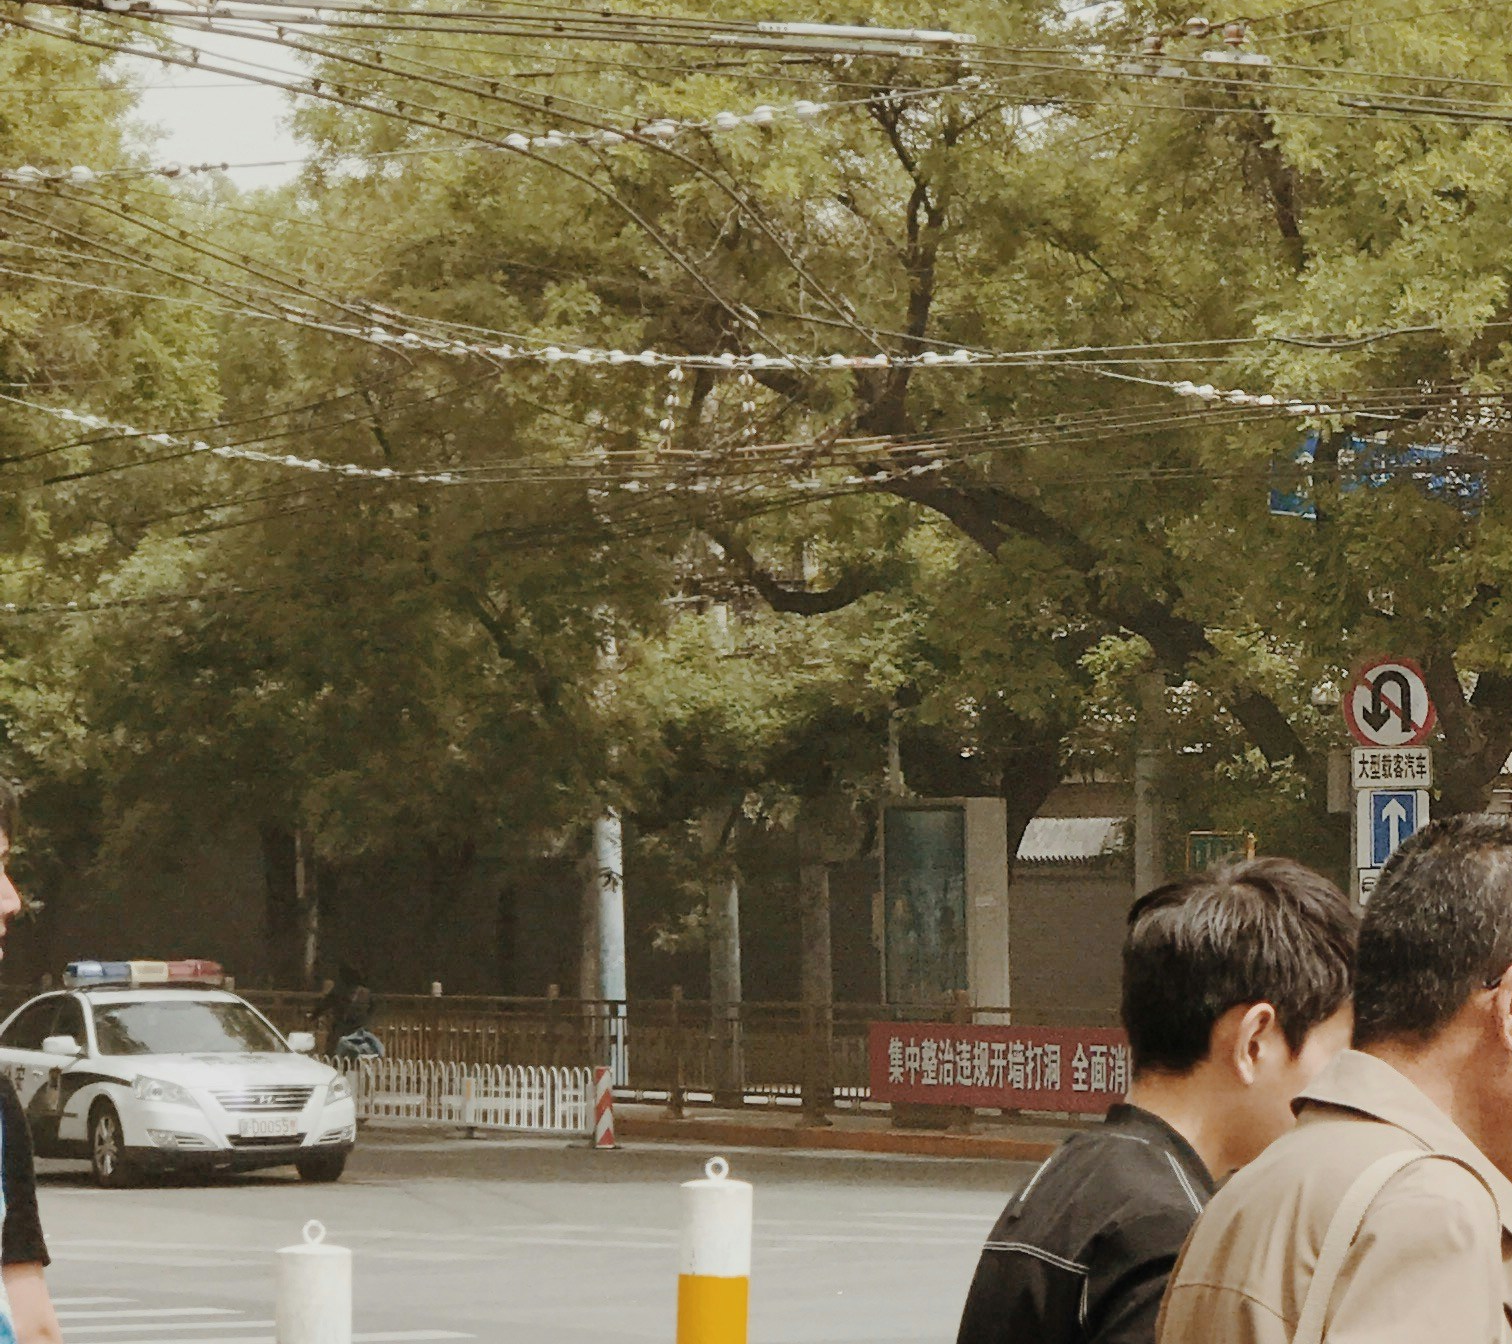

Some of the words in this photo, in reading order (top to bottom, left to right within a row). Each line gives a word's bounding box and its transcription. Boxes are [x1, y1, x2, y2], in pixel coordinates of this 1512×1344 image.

[1358, 752, 1427, 780] 大型载客汽车
[888, 1036, 1061, 1091] 集中整治违规开墙打洞
[1071, 1042, 1132, 1094] 全面消
